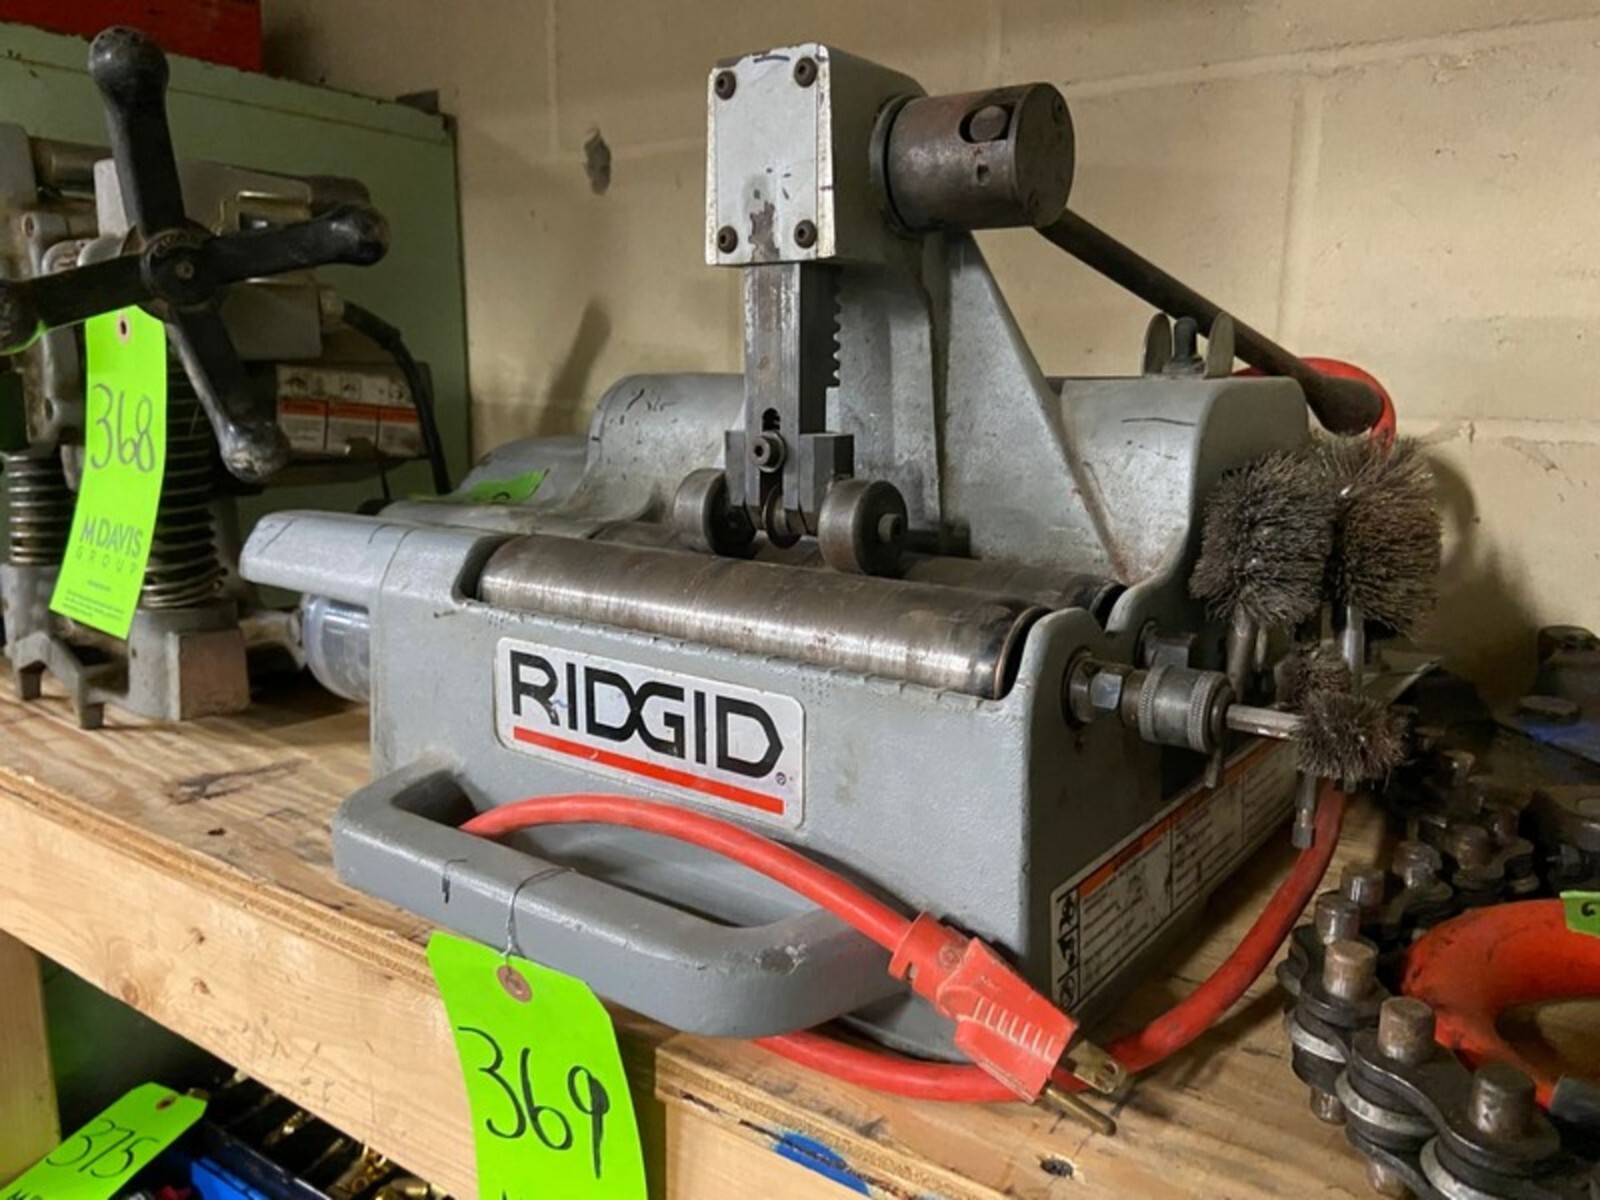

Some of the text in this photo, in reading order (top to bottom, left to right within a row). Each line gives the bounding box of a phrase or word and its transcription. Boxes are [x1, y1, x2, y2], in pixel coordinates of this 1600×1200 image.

[91, 383, 157, 473] 368
[76, 545, 138, 576] GROUP
[510, 649, 784, 779] RIDGID
[46, 1117, 161, 1179] 375
[457, 1026, 611, 1180] 369
